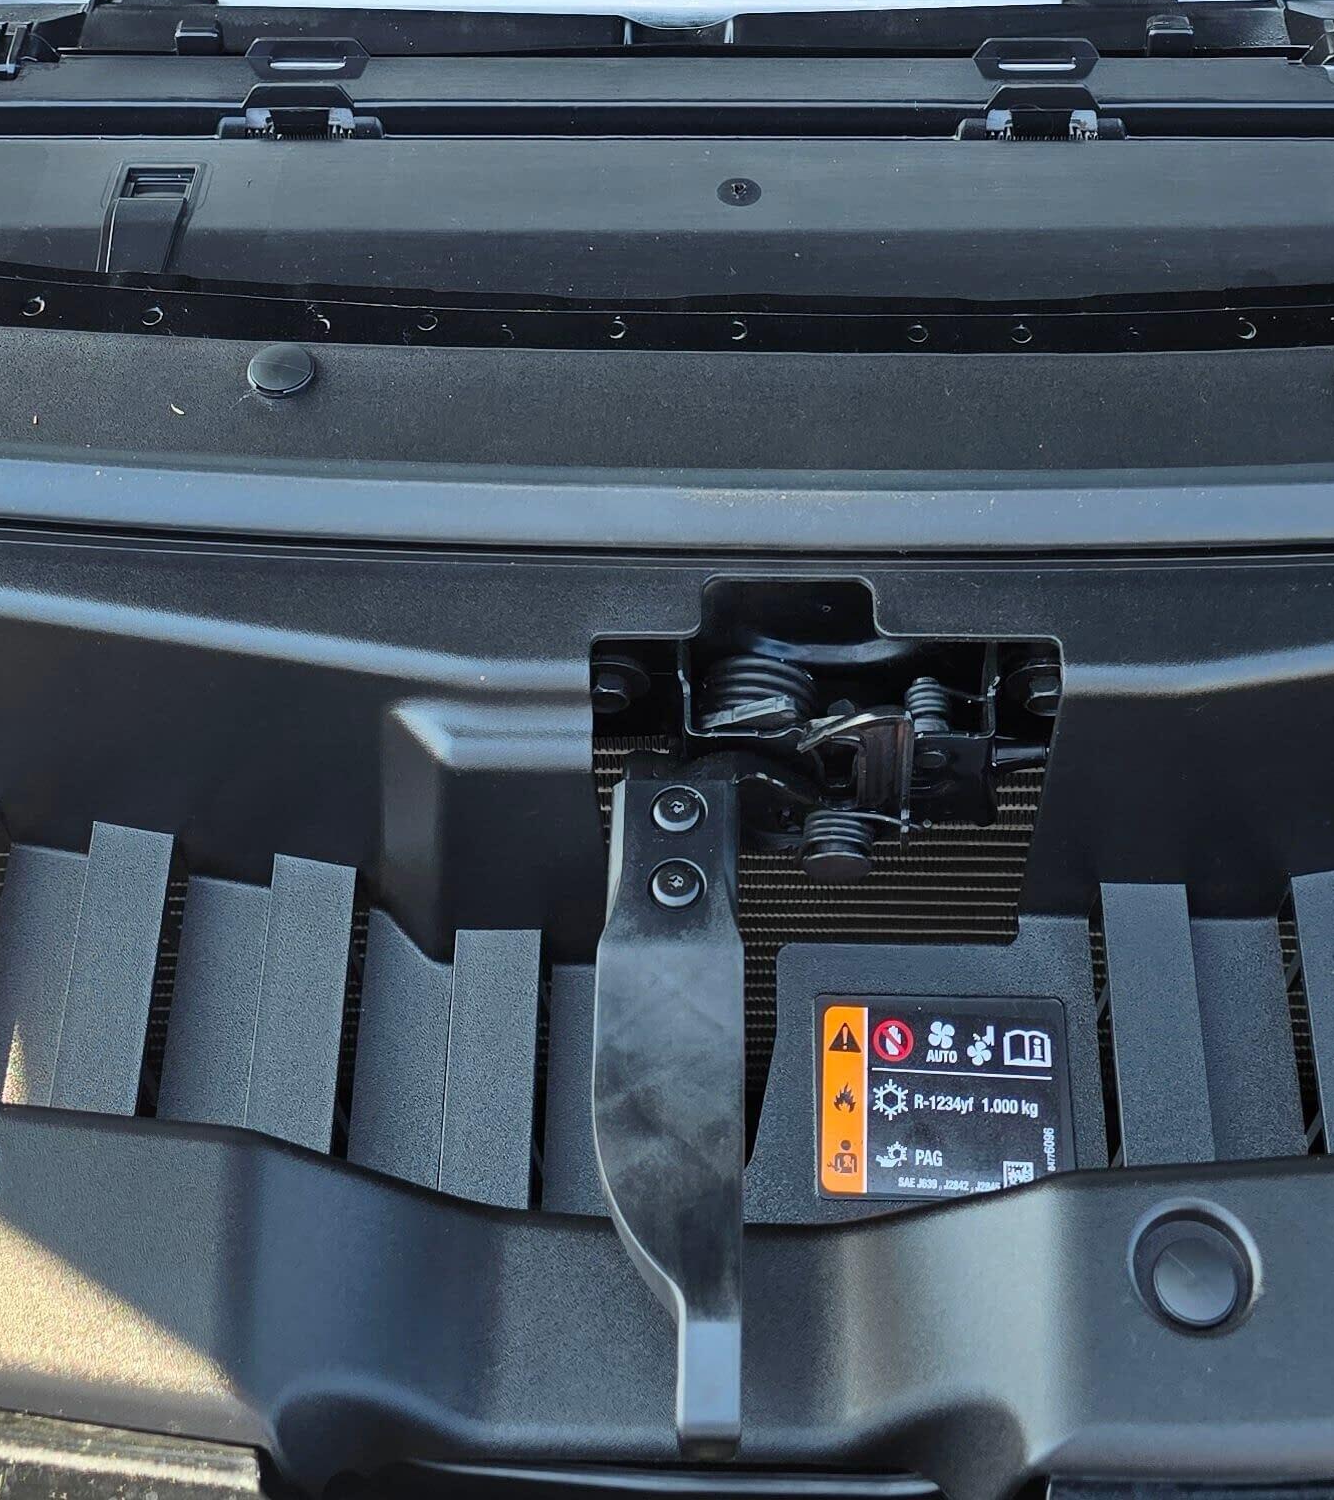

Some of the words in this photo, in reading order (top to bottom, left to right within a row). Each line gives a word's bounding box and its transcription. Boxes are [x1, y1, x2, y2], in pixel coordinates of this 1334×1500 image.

[925, 1049, 958, 1063] AUTO
[913, 1093, 974, 1115] R-1234yf
[981, 1097, 1019, 1114] 1.000
[1021, 1099, 1039, 1118] kg
[914, 1148, 943, 1167] PAG
[898, 1176, 916, 1188] SAE
